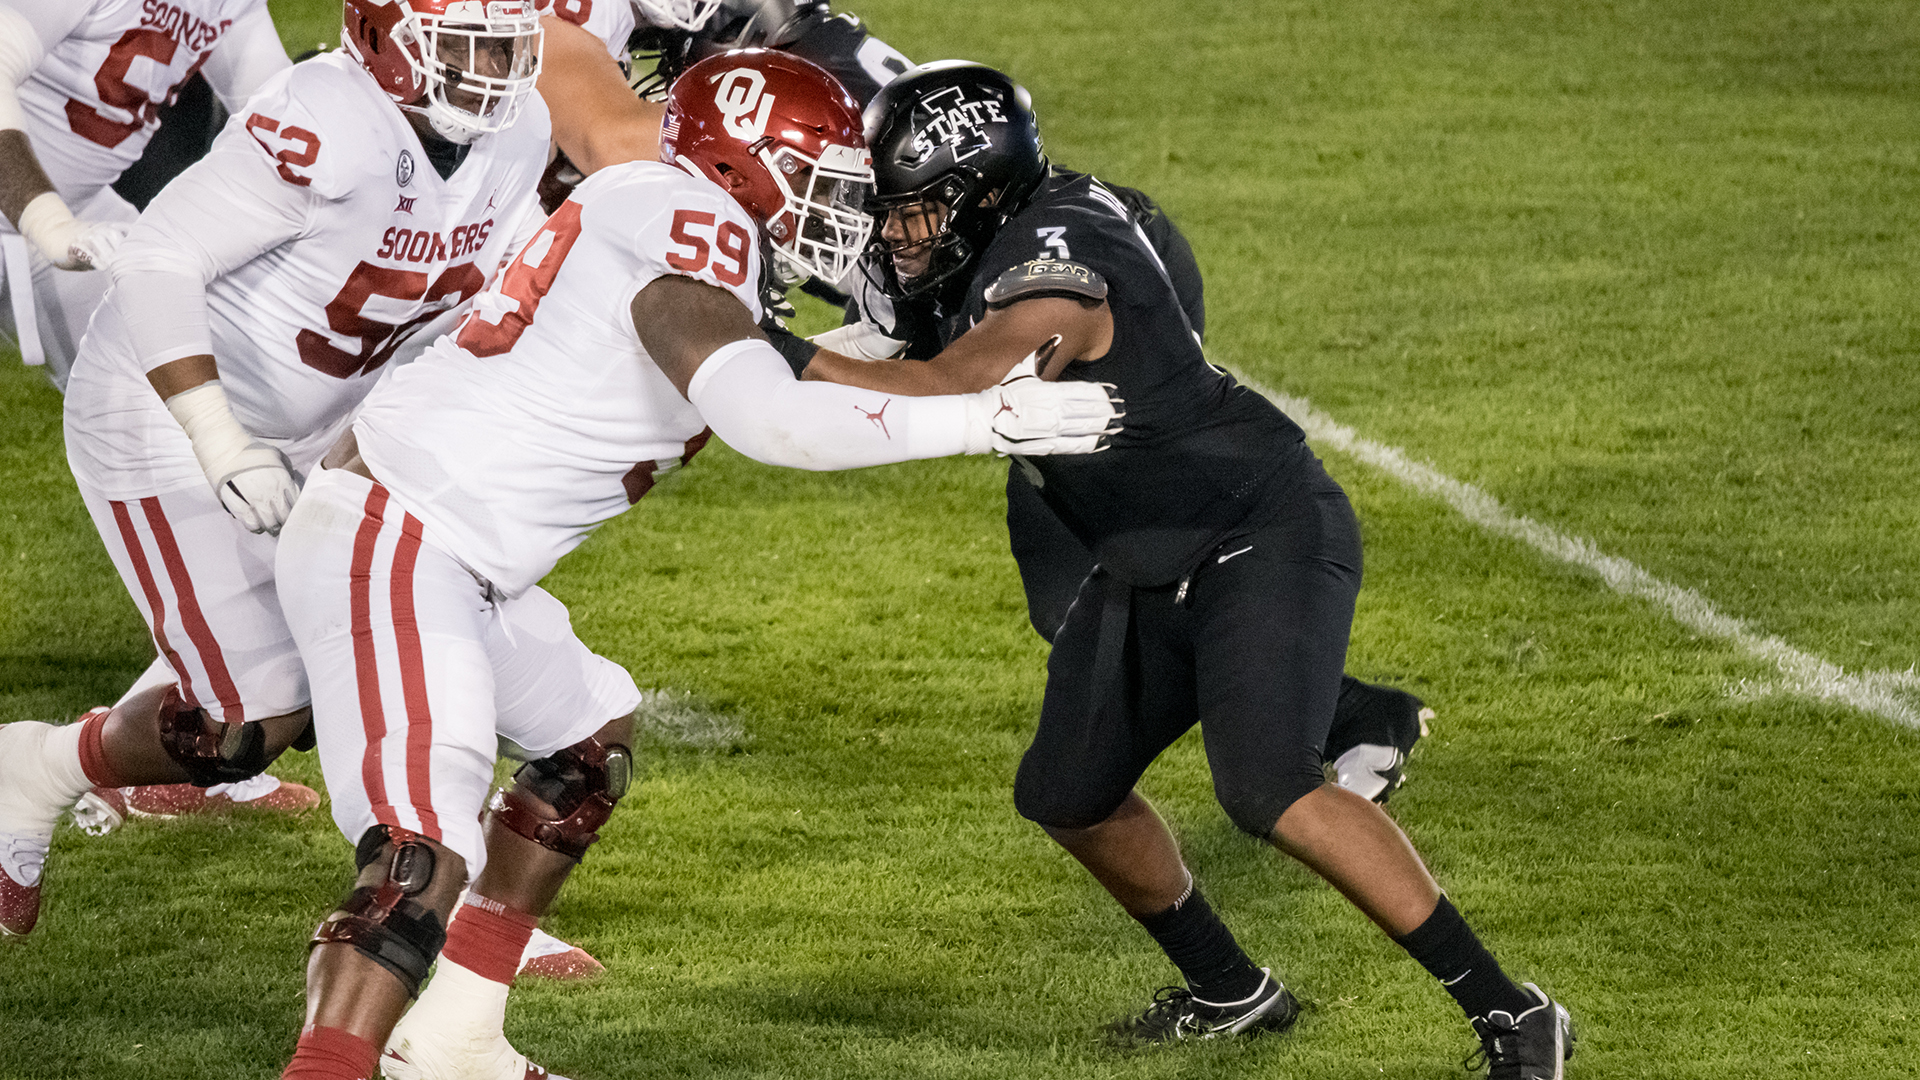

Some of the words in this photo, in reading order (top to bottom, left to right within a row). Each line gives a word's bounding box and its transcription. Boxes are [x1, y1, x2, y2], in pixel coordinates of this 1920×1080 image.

[714, 67, 776, 142] OU
[912, 100, 1008, 163] STATE
[245, 112, 322, 187] 52
[376, 218, 494, 264] SOONERS
[665, 209, 752, 287] 59
[1036, 226, 1070, 260] 3
[295, 259, 486, 380] 52
